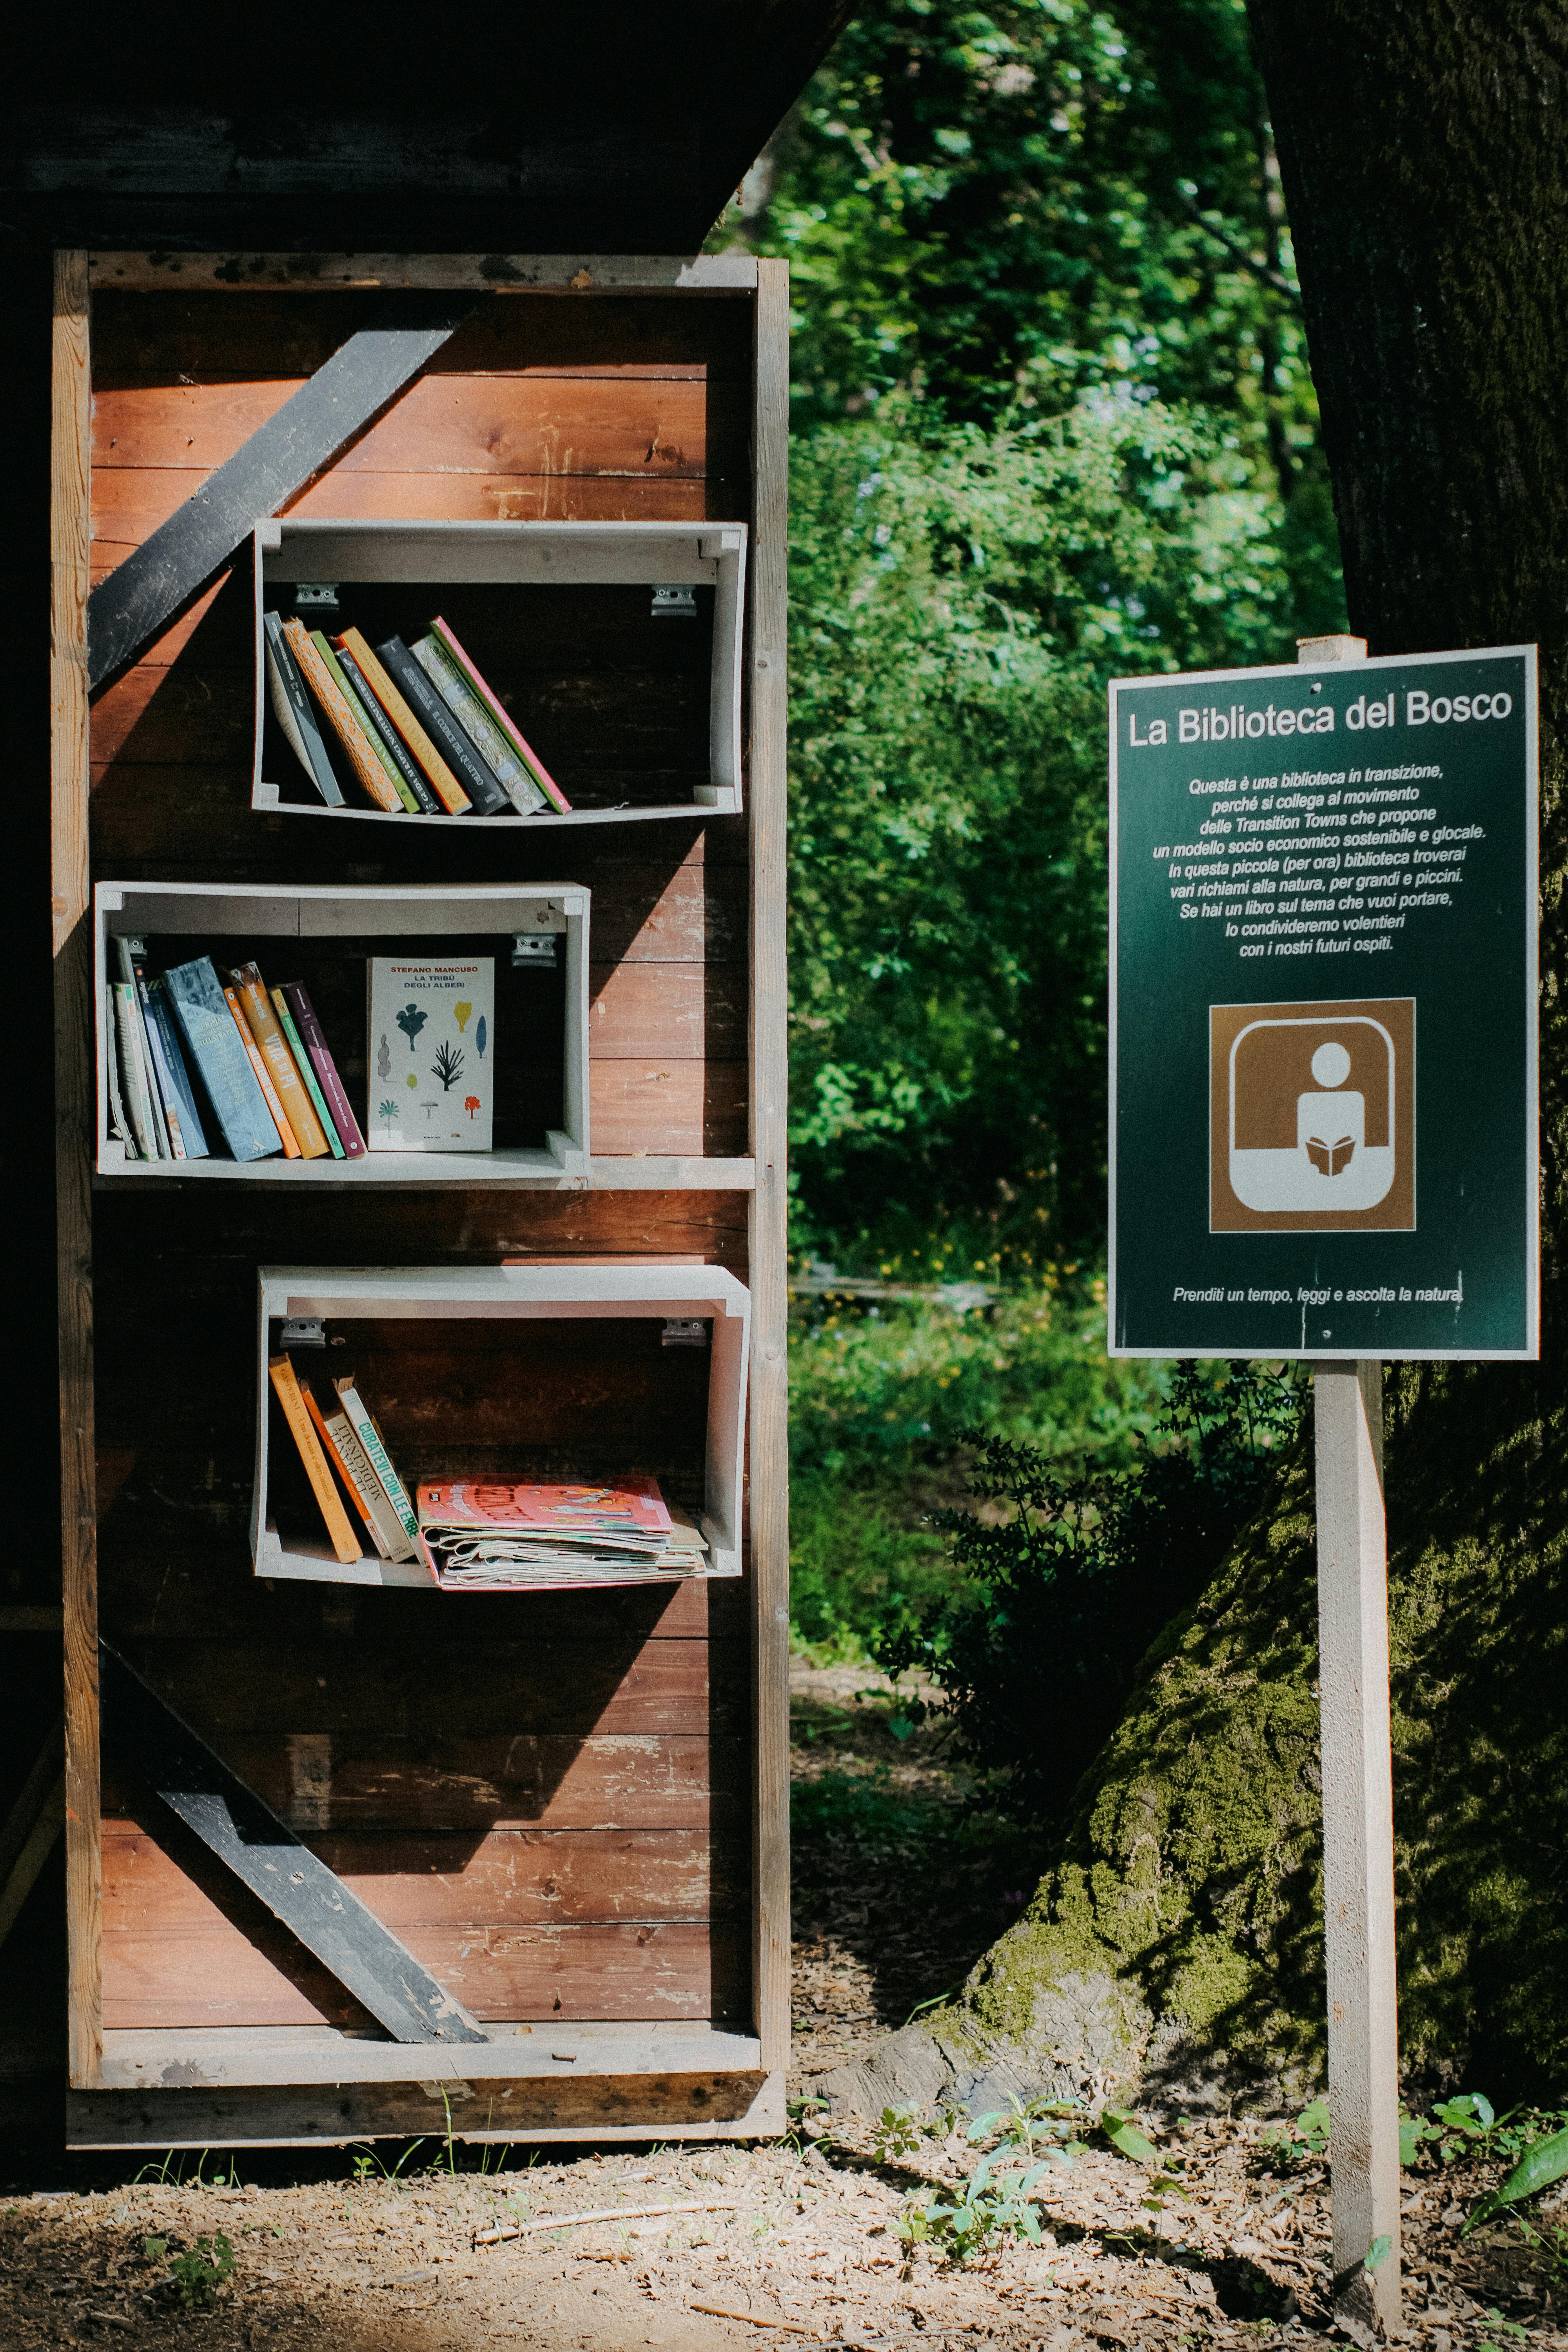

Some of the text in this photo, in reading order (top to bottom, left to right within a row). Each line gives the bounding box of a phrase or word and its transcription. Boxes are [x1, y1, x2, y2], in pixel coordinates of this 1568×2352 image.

[352, 672, 376, 708] D'EUROPA
[338, 677, 401, 780] DALLA PARTE DELLA NATURA
[372, 707, 397, 745] NOTTURNI
[1130, 690, 1512, 747] La Biblioteca del Bosco
[393, 744, 411, 770] RAPACI
[431, 710, 485, 787] IL CODICE DEL QUATTRO
[407, 768, 416, 779] AI
[1189, 764, 1443, 795] Questa è una biblioteca in transizione,
[412, 777, 430, 802] GUIDA
[1211, 786, 1420, 817] perché si collega al movimento
[1200, 808, 1437, 835] delle Transition Towns che propone
[1152, 824, 1486, 859] un modello socio economico sostenibile e glocale.
[1168, 846, 1467, 880] In questa piccola (per ora) biblioteca troverai
[1170, 867, 1463, 899] vari richiami alla natura, per grandi e piccini.
[1180, 891, 1453, 919] Se hai un libro sul tema che vuoi portare,
[1225, 913, 1406, 937] lo condivideremo volentieri
[1239, 935, 1394, 958] con i nostri futuri ospiti.
[138, 981, 150, 1005] aquile
[247, 982, 258, 1000] Yann
[200, 1016, 223, 1030] PRIMA
[200, 1029, 234, 1046] ILLUSTRATA
[263, 1032, 287, 1063] VITA
[278, 1071, 298, 1090] PI
[247, 1042, 286, 1123] NELLE TERRE SELVAGGE
[1172, 1287, 1225, 1302] Prenditi
[1227, 1290, 1245, 1302] un
[1247, 1287, 1293, 1305] tempo,
[1297, 1287, 1332, 1303] leggi
[1333, 1290, 1343, 1302] e
[1345, 1286, 1396, 1302] ascolta
[1398, 1286, 1412, 1301] la
[297, 1417, 309, 1433] Una
[303, 1432, 317, 1455] donna
[328, 1428, 358, 1475] PIANTE
[313, 1460, 325, 1476] altri
[337, 1423, 383, 1501] MEDICINALI
[318, 1474, 335, 1502] animali
[352, 1476, 367, 1494] LE
[357, 1420, 420, 1539] CURATEVI CON LE ERBE
